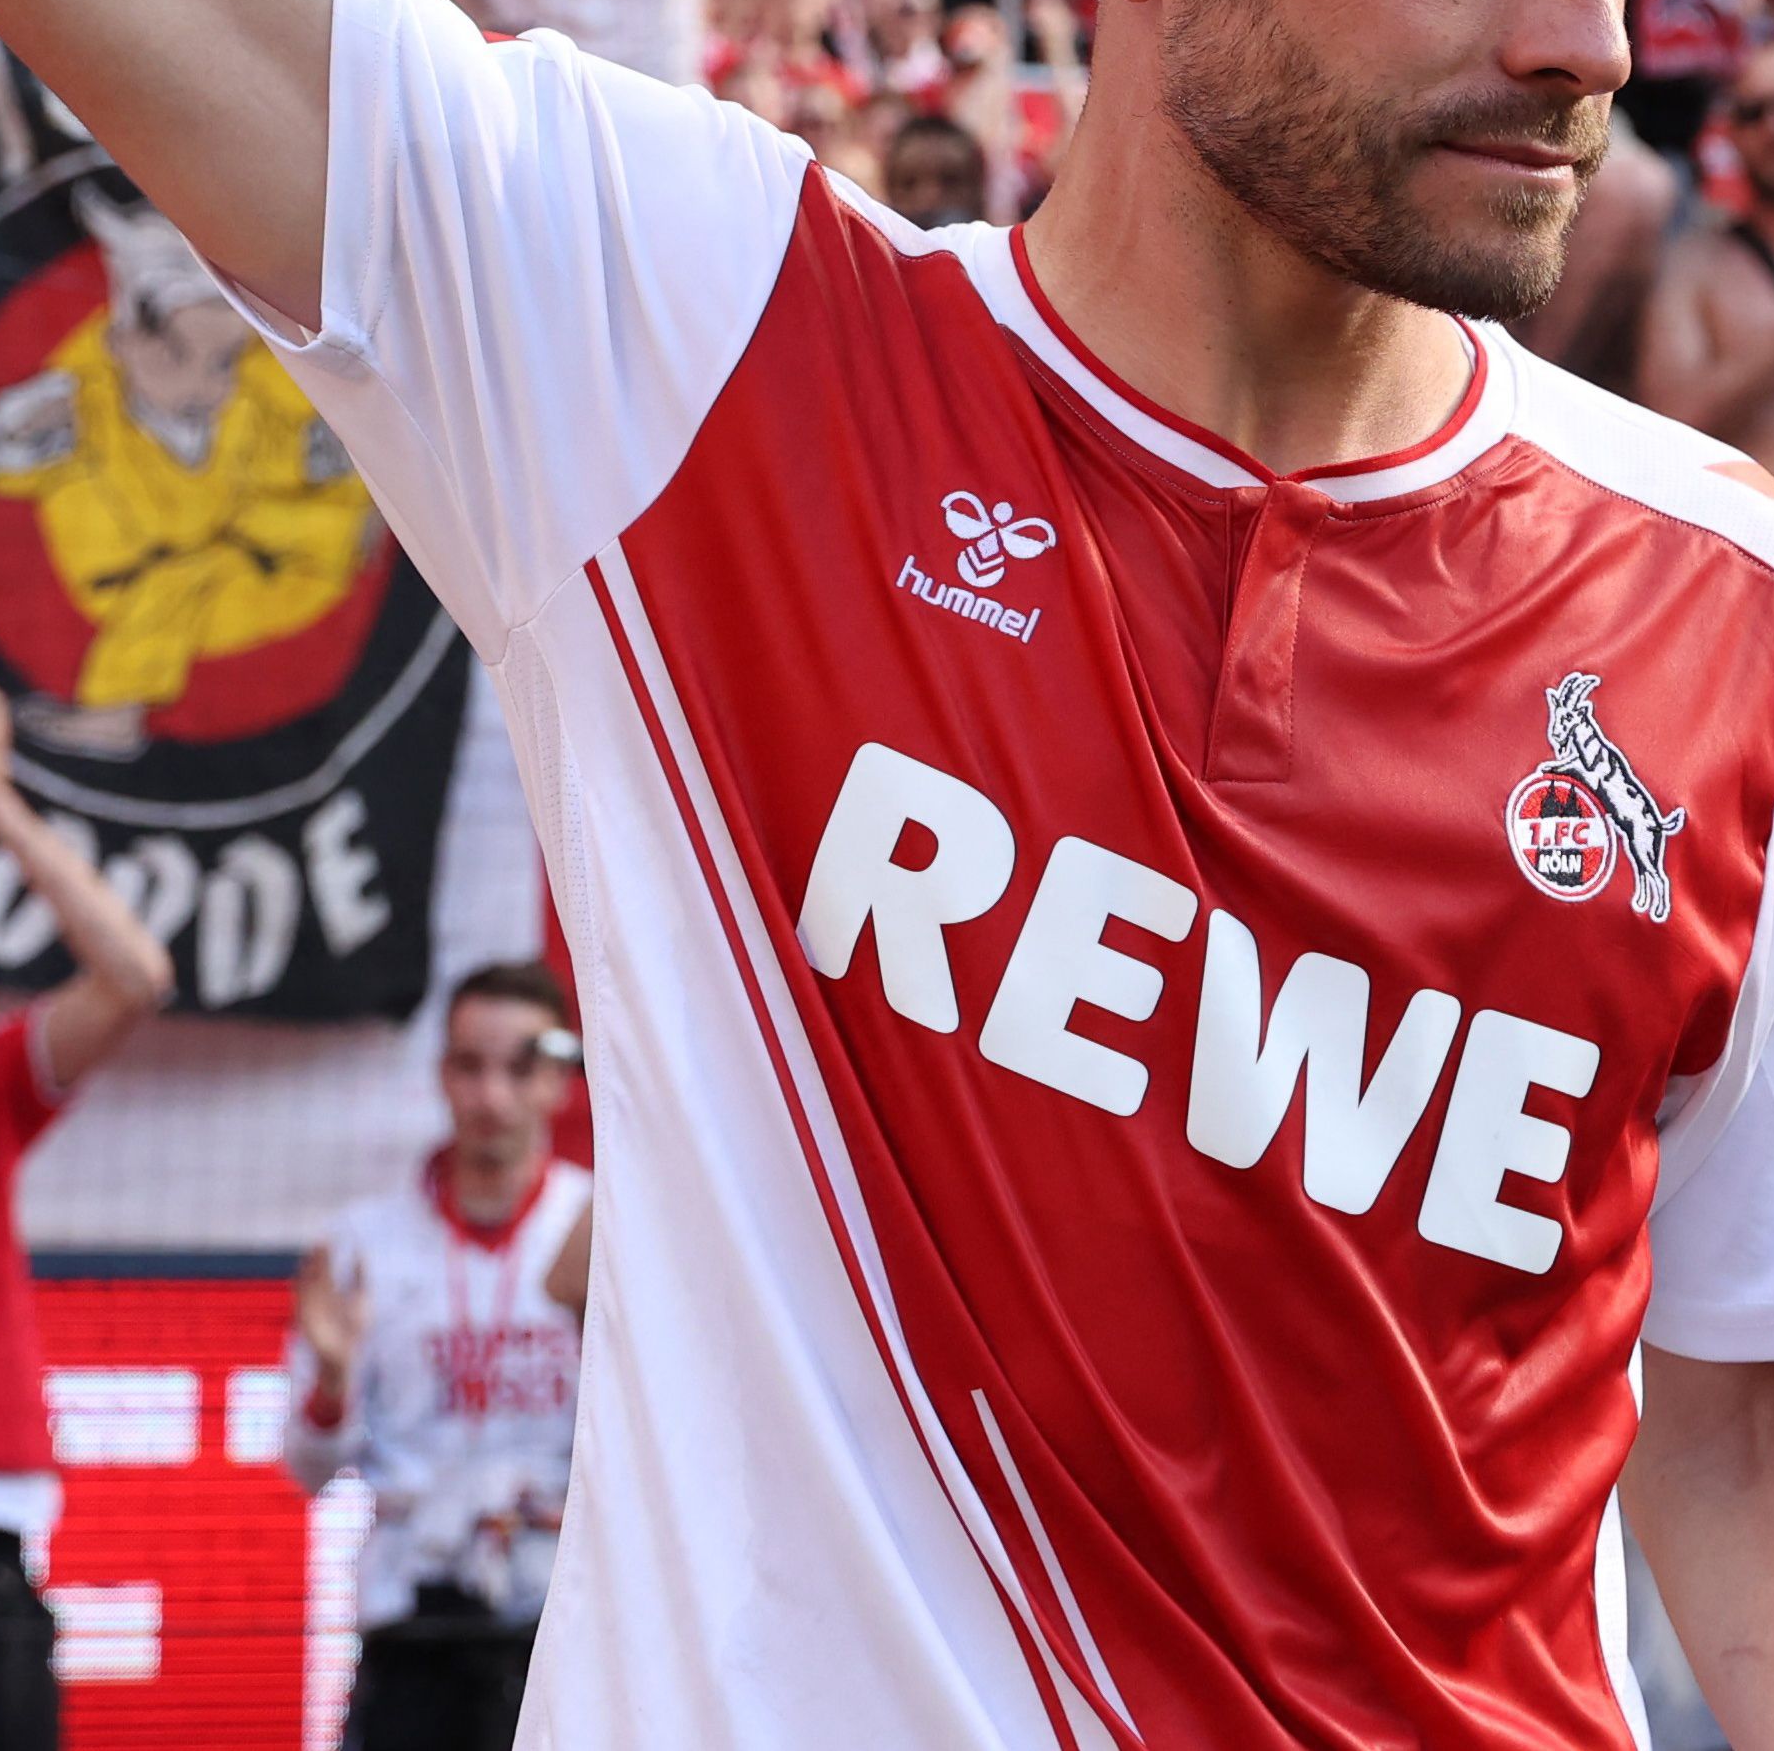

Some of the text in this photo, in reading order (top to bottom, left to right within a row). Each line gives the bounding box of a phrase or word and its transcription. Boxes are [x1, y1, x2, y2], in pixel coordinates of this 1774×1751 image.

[895, 554, 1042, 644] hummel
[1529, 821, 1591, 847] 1.FC
[1537, 849, 1583, 874] KÖLN
[795, 741, 1601, 1276] REWE
